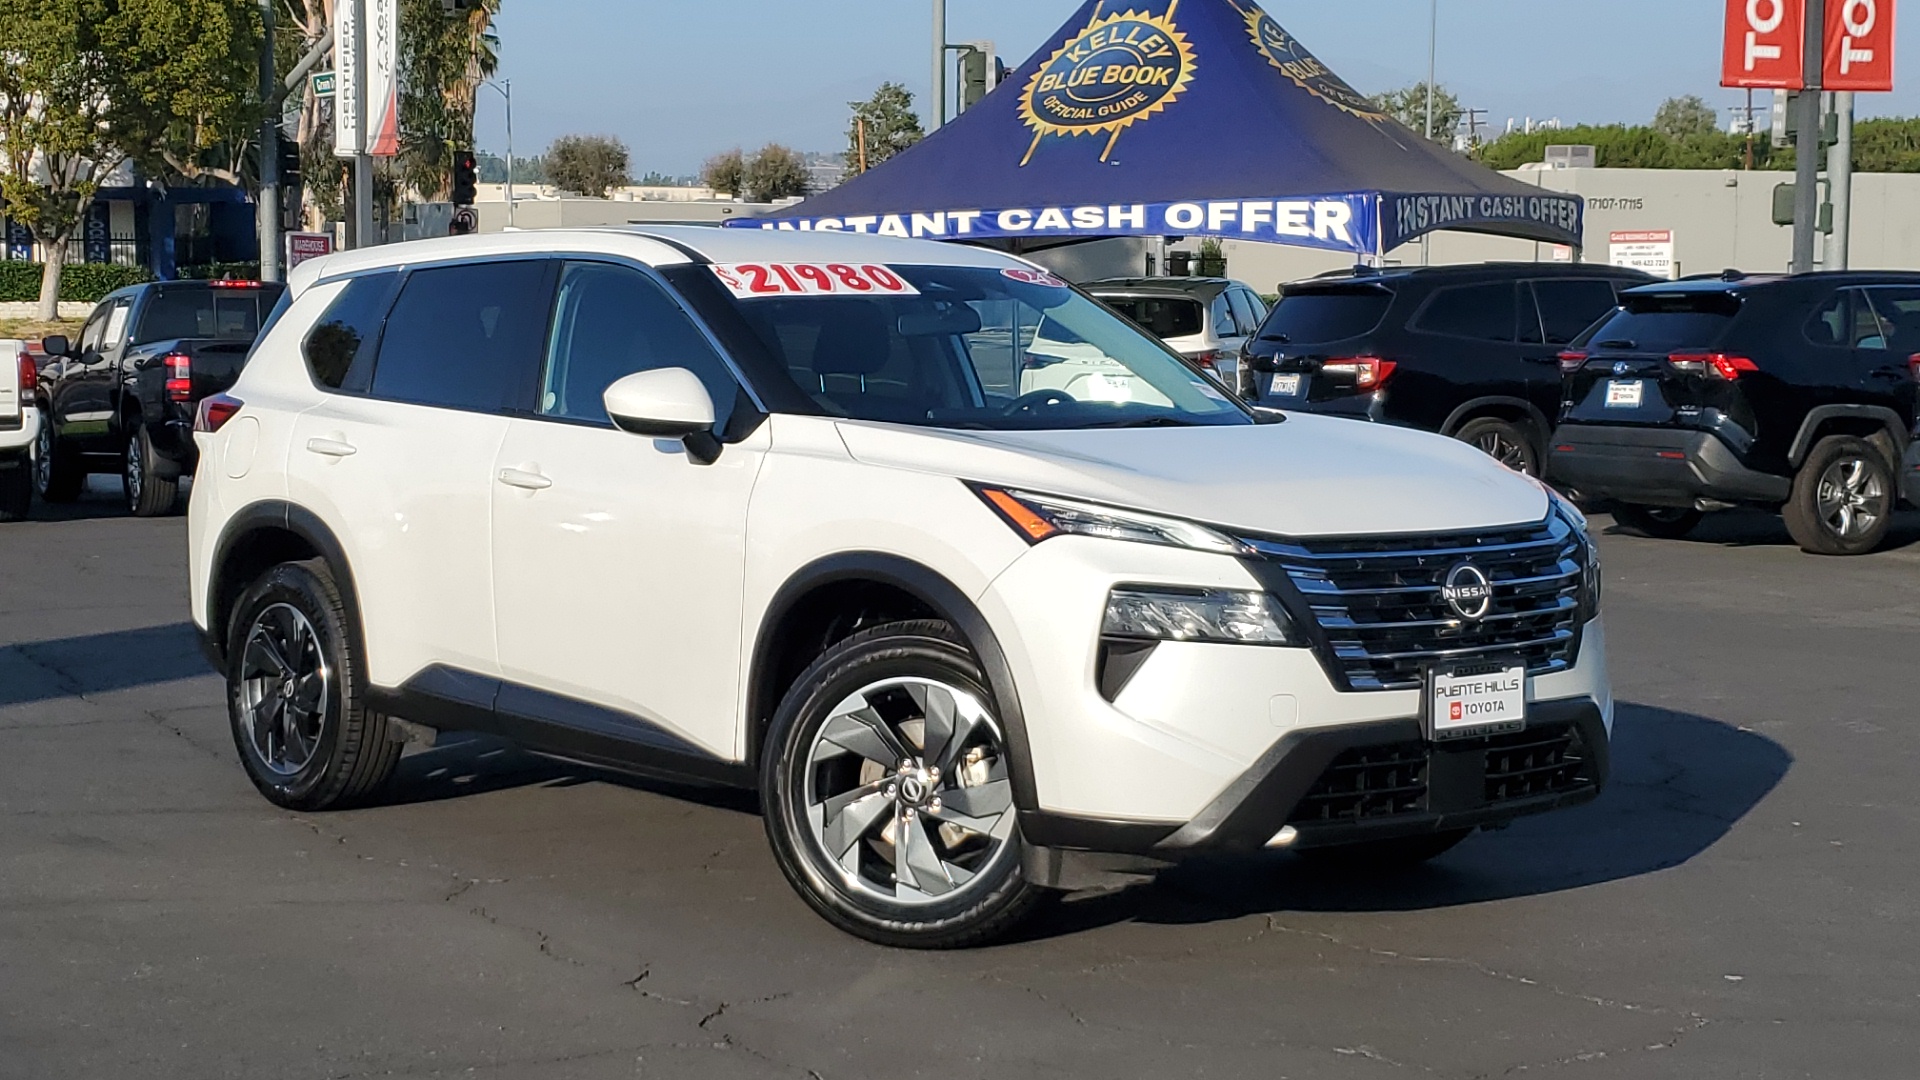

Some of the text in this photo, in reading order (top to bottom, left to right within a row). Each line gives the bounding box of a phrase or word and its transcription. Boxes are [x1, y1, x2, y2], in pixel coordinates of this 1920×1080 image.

[1066, 26, 1173, 63] KELLEY
[1037, 65, 1174, 93] BLUE BOOK
[1043, 91, 1149, 119] OFFICIAL GUIDE
[762, 201, 1352, 242] STANT CASH OFFER
[1396, 196, 1578, 238] INSTANT CASH OFFER
[1445, 586, 1491, 599] NISSAN
[1436, 679, 1519, 699] PUENTE HILLS
[1464, 700, 1505, 715] TOYOTA
